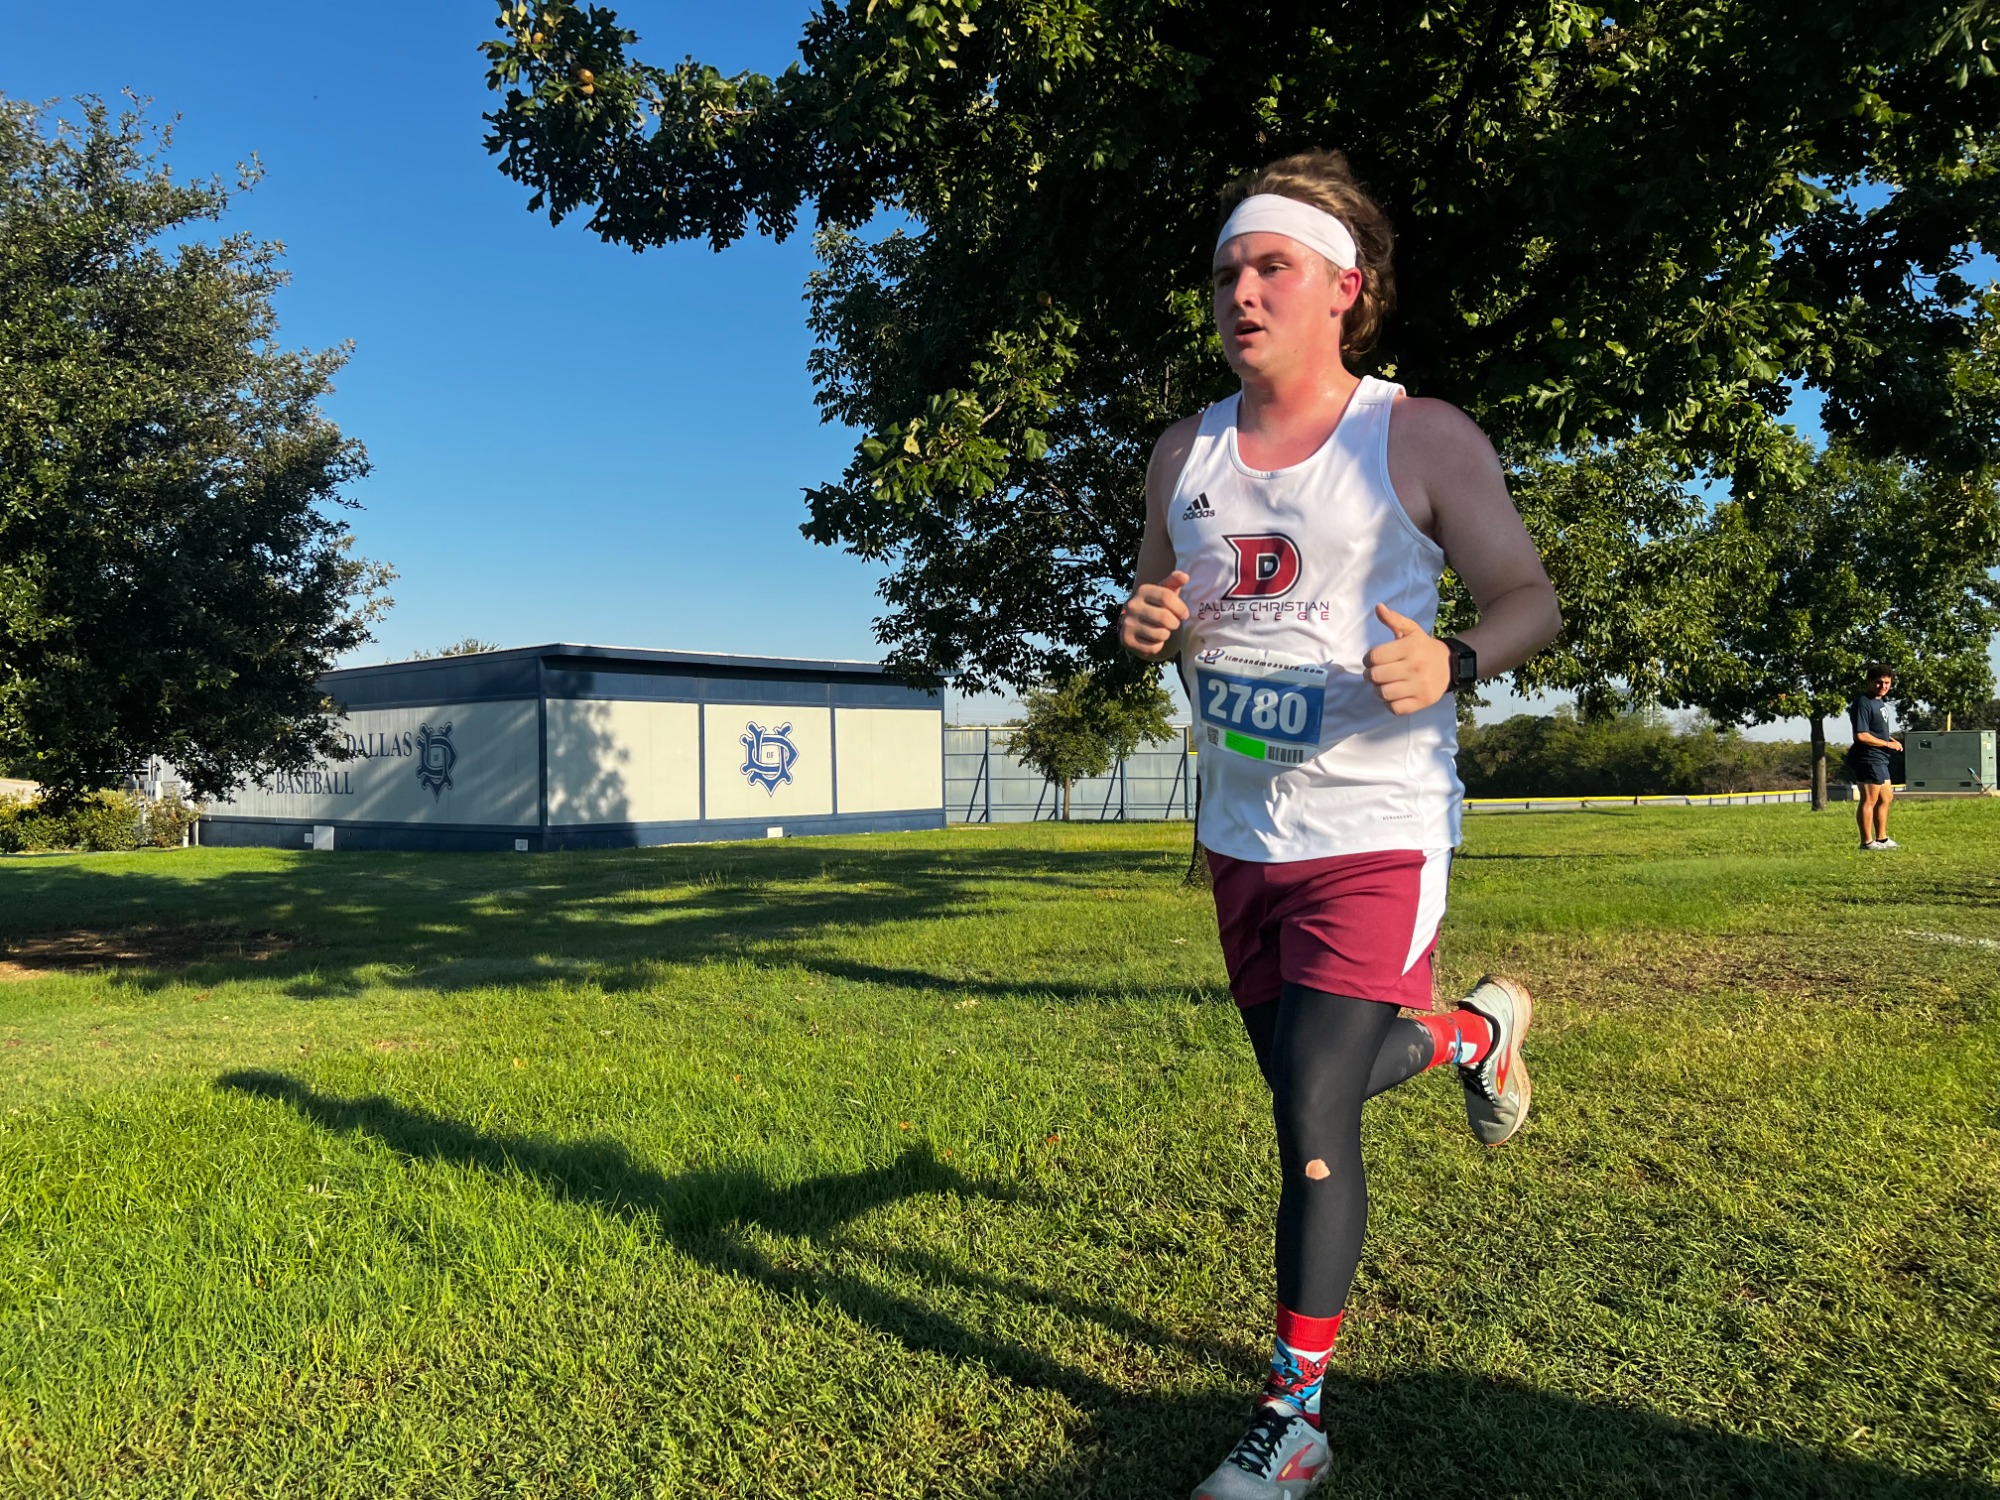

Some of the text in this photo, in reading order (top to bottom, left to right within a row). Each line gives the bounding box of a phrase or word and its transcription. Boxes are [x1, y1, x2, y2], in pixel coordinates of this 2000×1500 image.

[1182, 508, 1215, 521] adidas
[1220, 532, 1302, 601] D
[1197, 611, 1330, 621] COLLEGE
[1248, 600, 1330, 612] CHRISTIAN
[1223, 654, 1325, 676] timeandmeasure.com
[1207, 678, 1308, 735] 2780
[345, 731, 413, 758] DALLAS
[275, 770, 354, 795] BASEBALL
